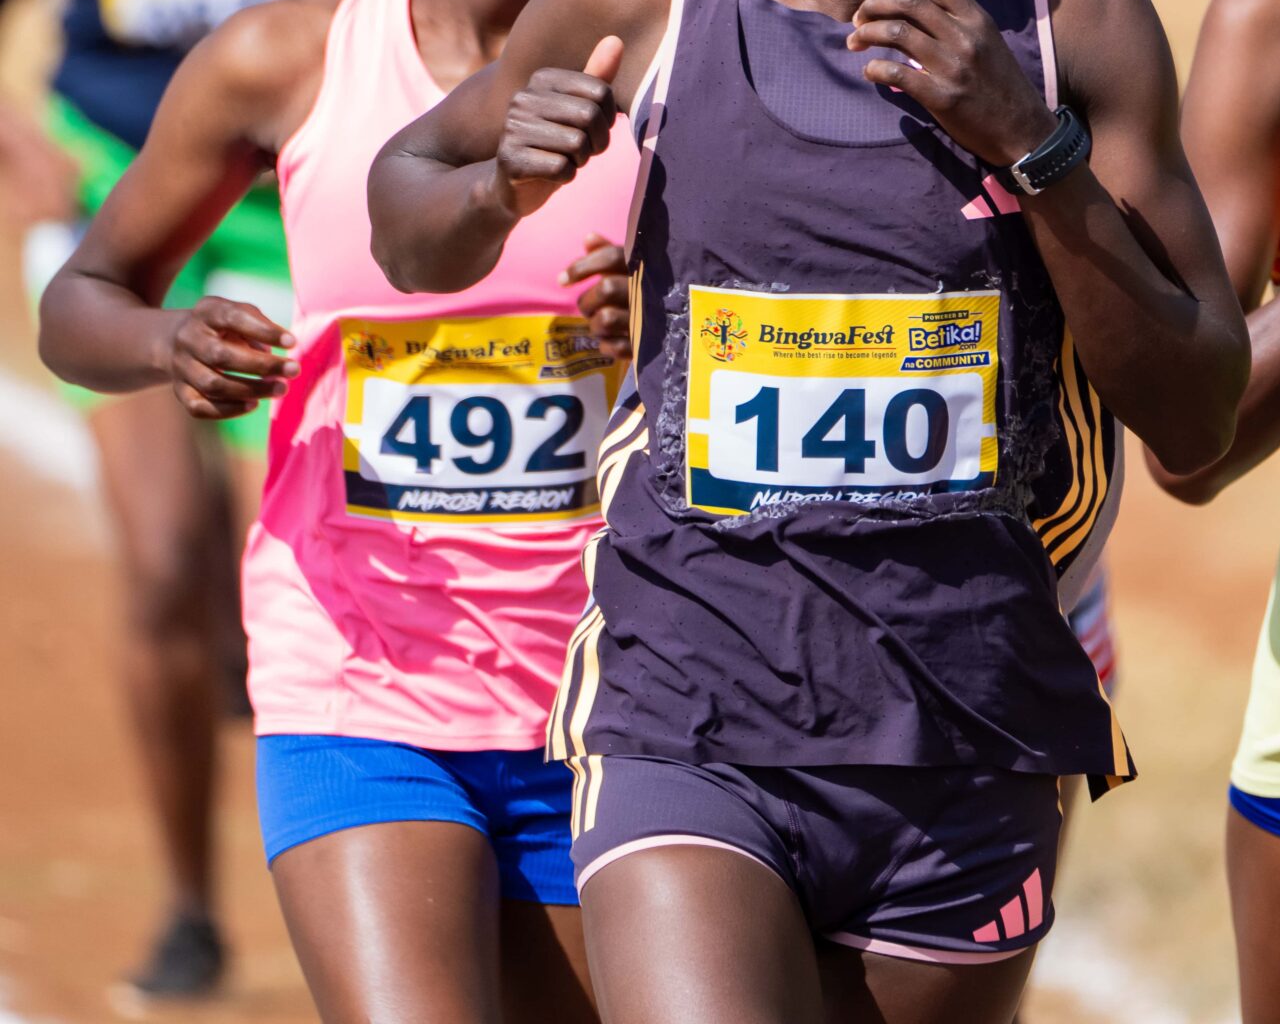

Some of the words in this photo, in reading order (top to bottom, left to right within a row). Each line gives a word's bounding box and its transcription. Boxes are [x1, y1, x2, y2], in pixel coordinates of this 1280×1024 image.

[759, 324, 895, 350] BingwaFest
[910, 322, 981, 350] Betika!
[872, 352, 897, 360] legends
[915, 354, 986, 368] COMMUNITY
[380, 394, 586, 476] 492
[736, 386, 949, 474] 140
[398, 488, 488, 512] NAIROBI
[490, 487, 575, 512] REGION
